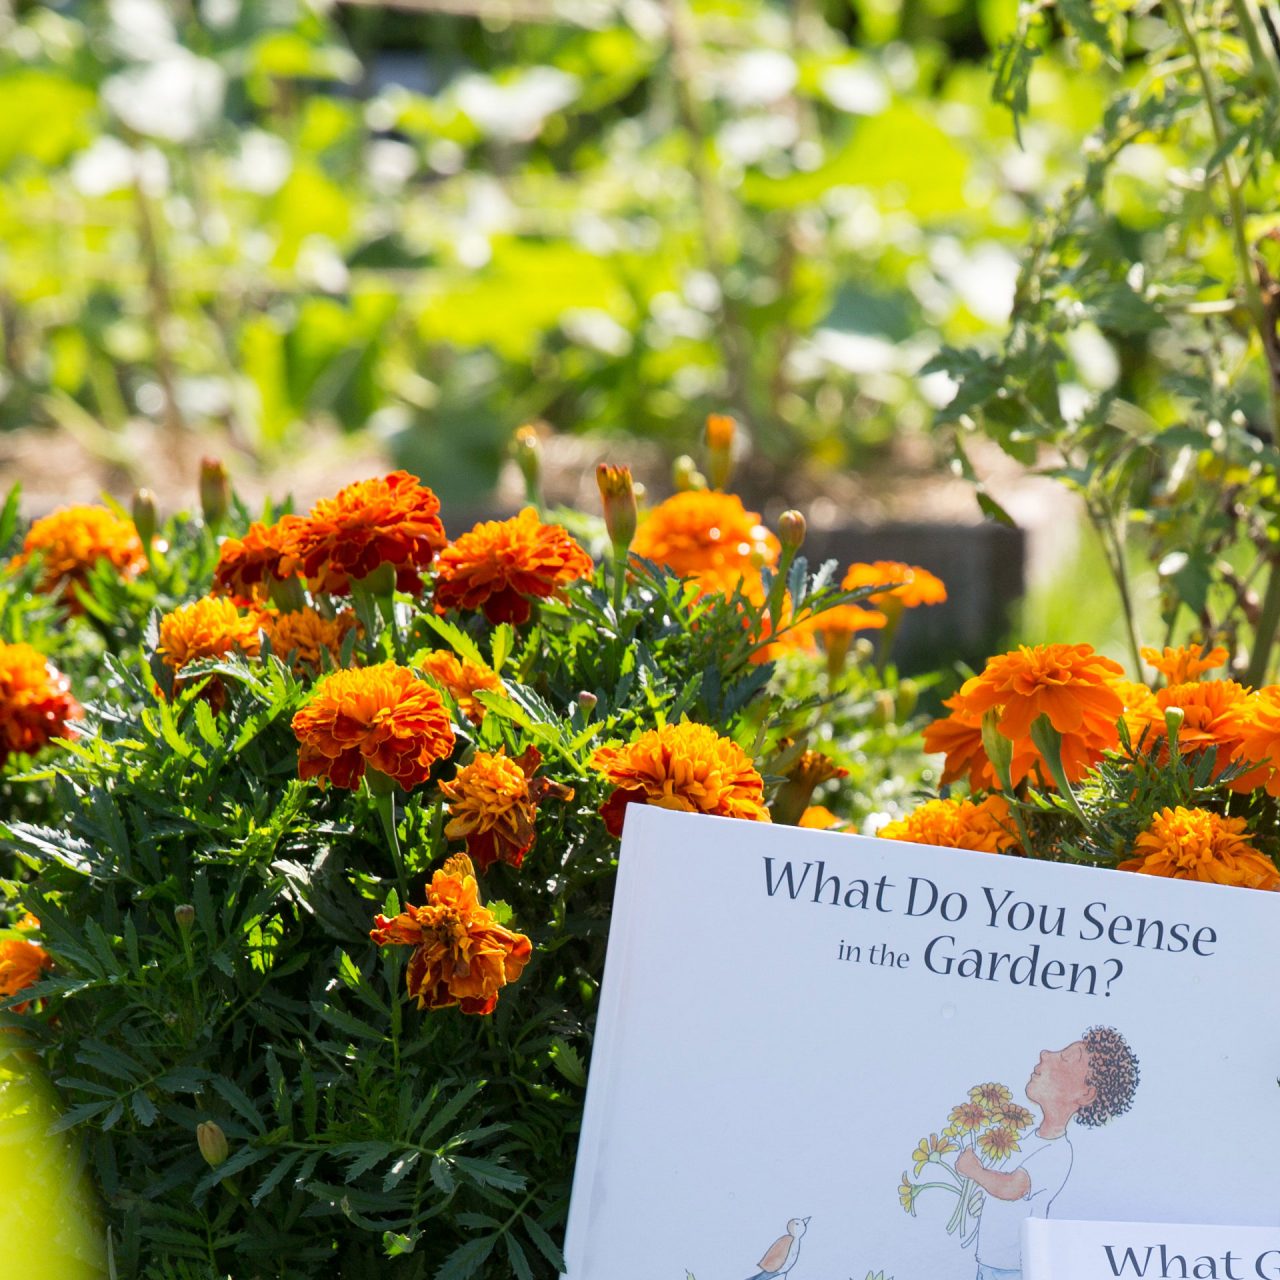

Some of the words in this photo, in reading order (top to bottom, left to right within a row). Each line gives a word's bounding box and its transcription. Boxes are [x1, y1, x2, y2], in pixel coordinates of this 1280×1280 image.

[762, 856, 896, 914] What
[904, 876, 968, 923] Do
[980, 886, 1066, 938] You
[1079, 901, 1218, 957] Sense
[837, 938, 861, 963] in
[868, 943, 910, 969] the
[923, 934, 1124, 998] Garden?
